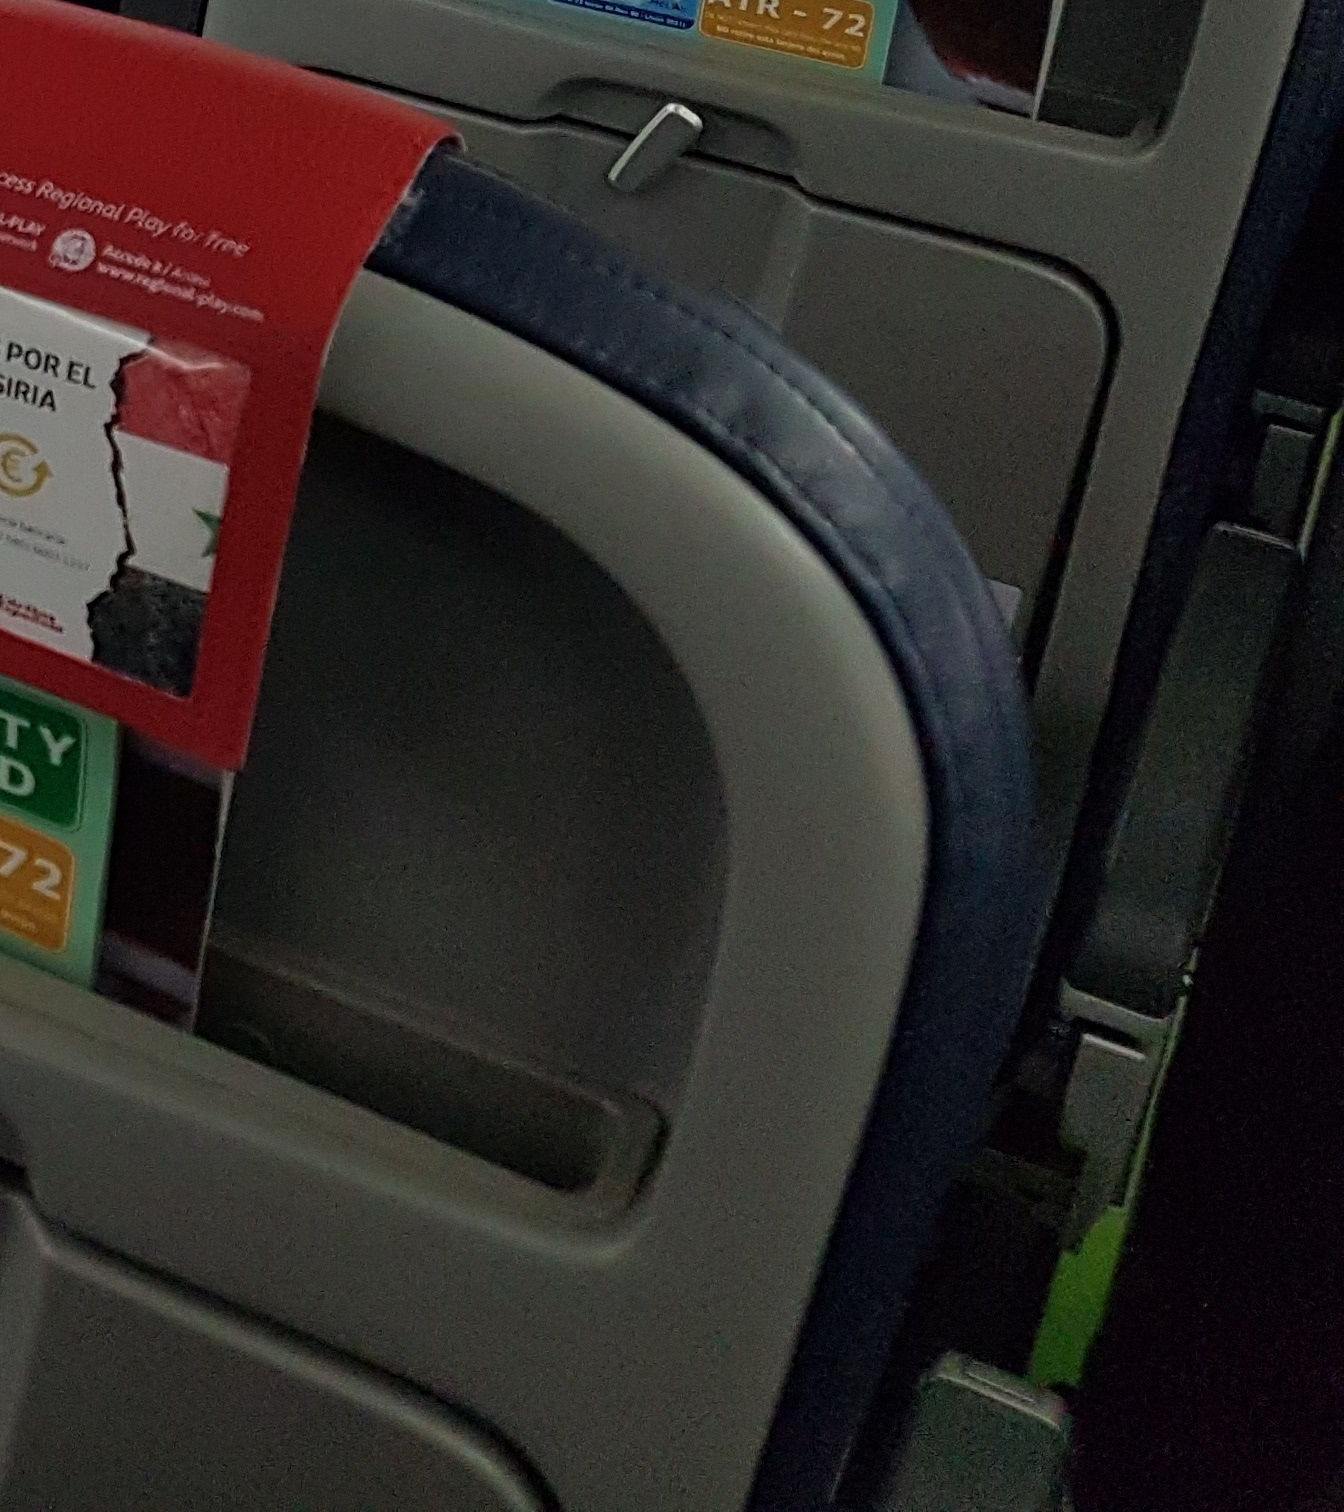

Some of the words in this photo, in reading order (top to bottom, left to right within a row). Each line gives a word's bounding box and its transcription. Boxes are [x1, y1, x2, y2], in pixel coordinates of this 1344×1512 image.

[822, 7, 866, 37] 72
[34, 178, 126, 225] Regional
[123, 204, 173, 241] Play
[4, 340, 61, 377] POR
[65, 359, 99, 389] EL
